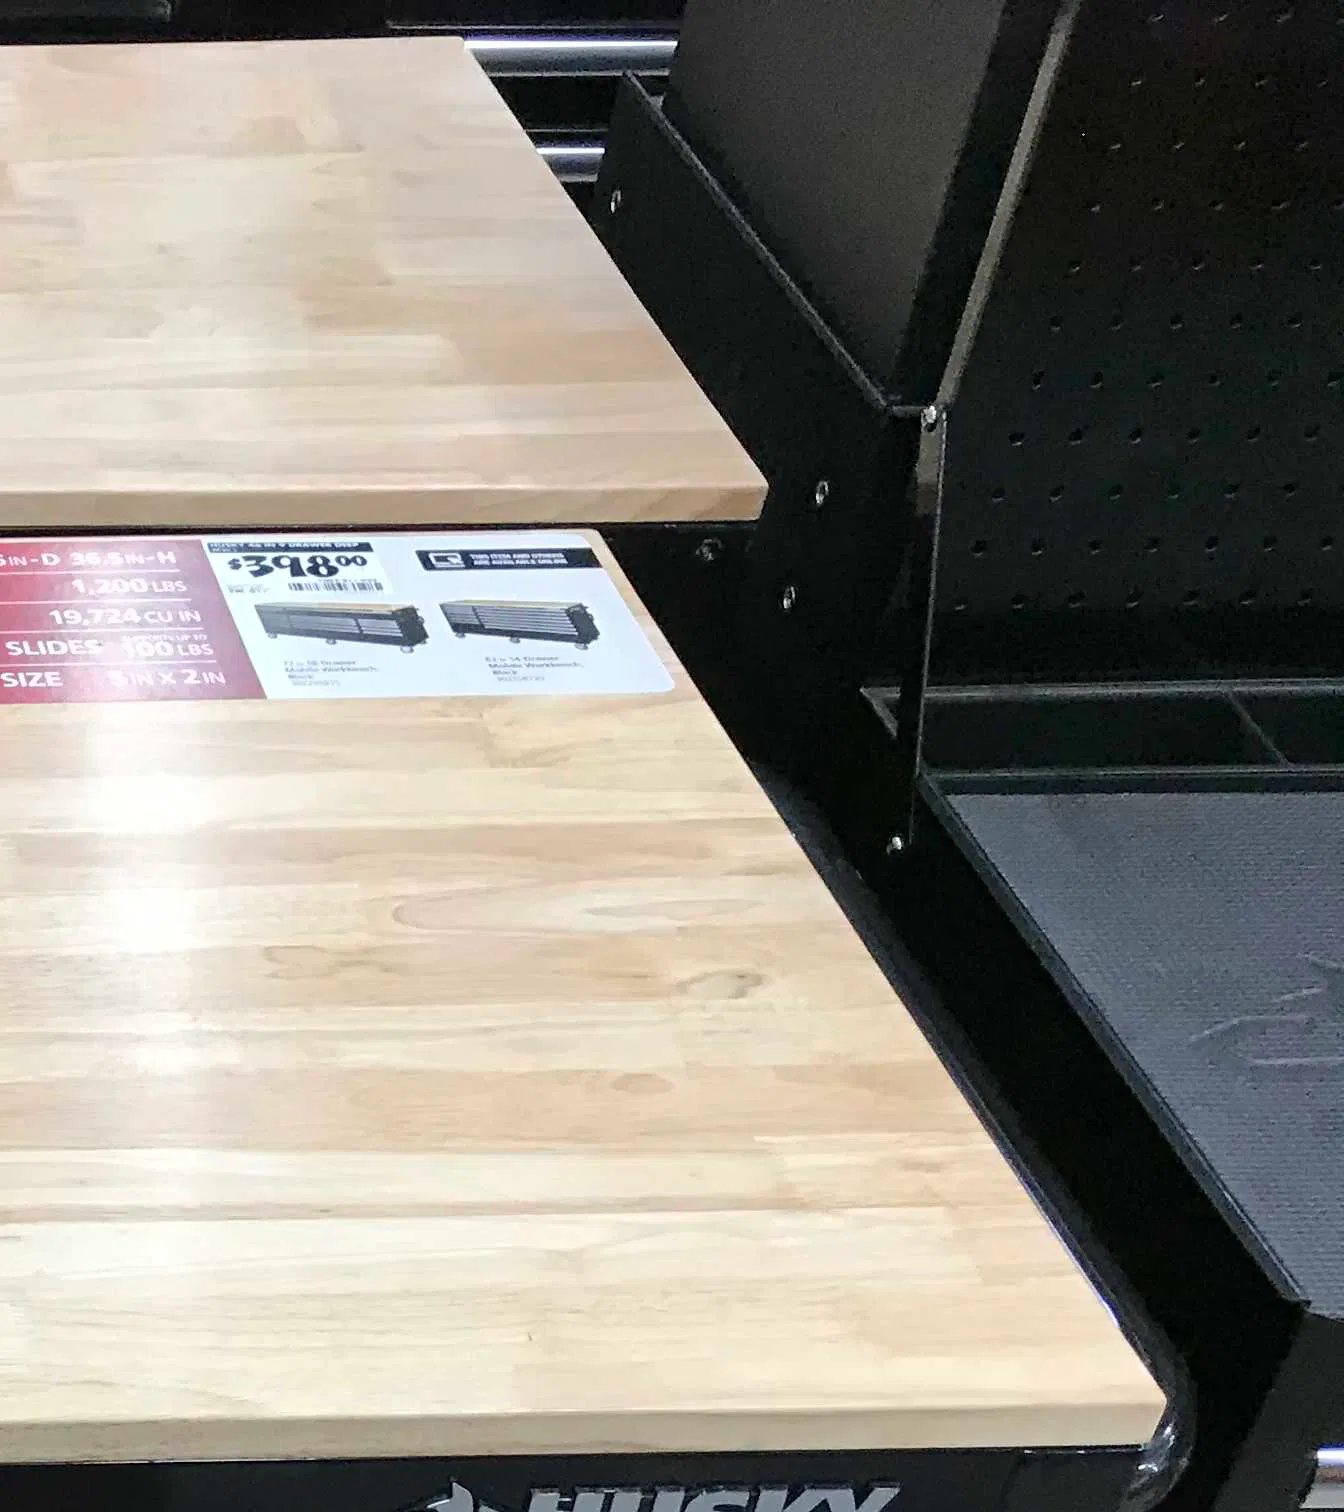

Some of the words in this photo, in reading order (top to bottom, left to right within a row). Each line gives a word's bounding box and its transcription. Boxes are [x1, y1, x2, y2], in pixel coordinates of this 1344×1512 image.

[180, 610, 201, 623] IN
[7, 640, 103, 657] SLIDES
[1, 671, 62, 689] SIZE
